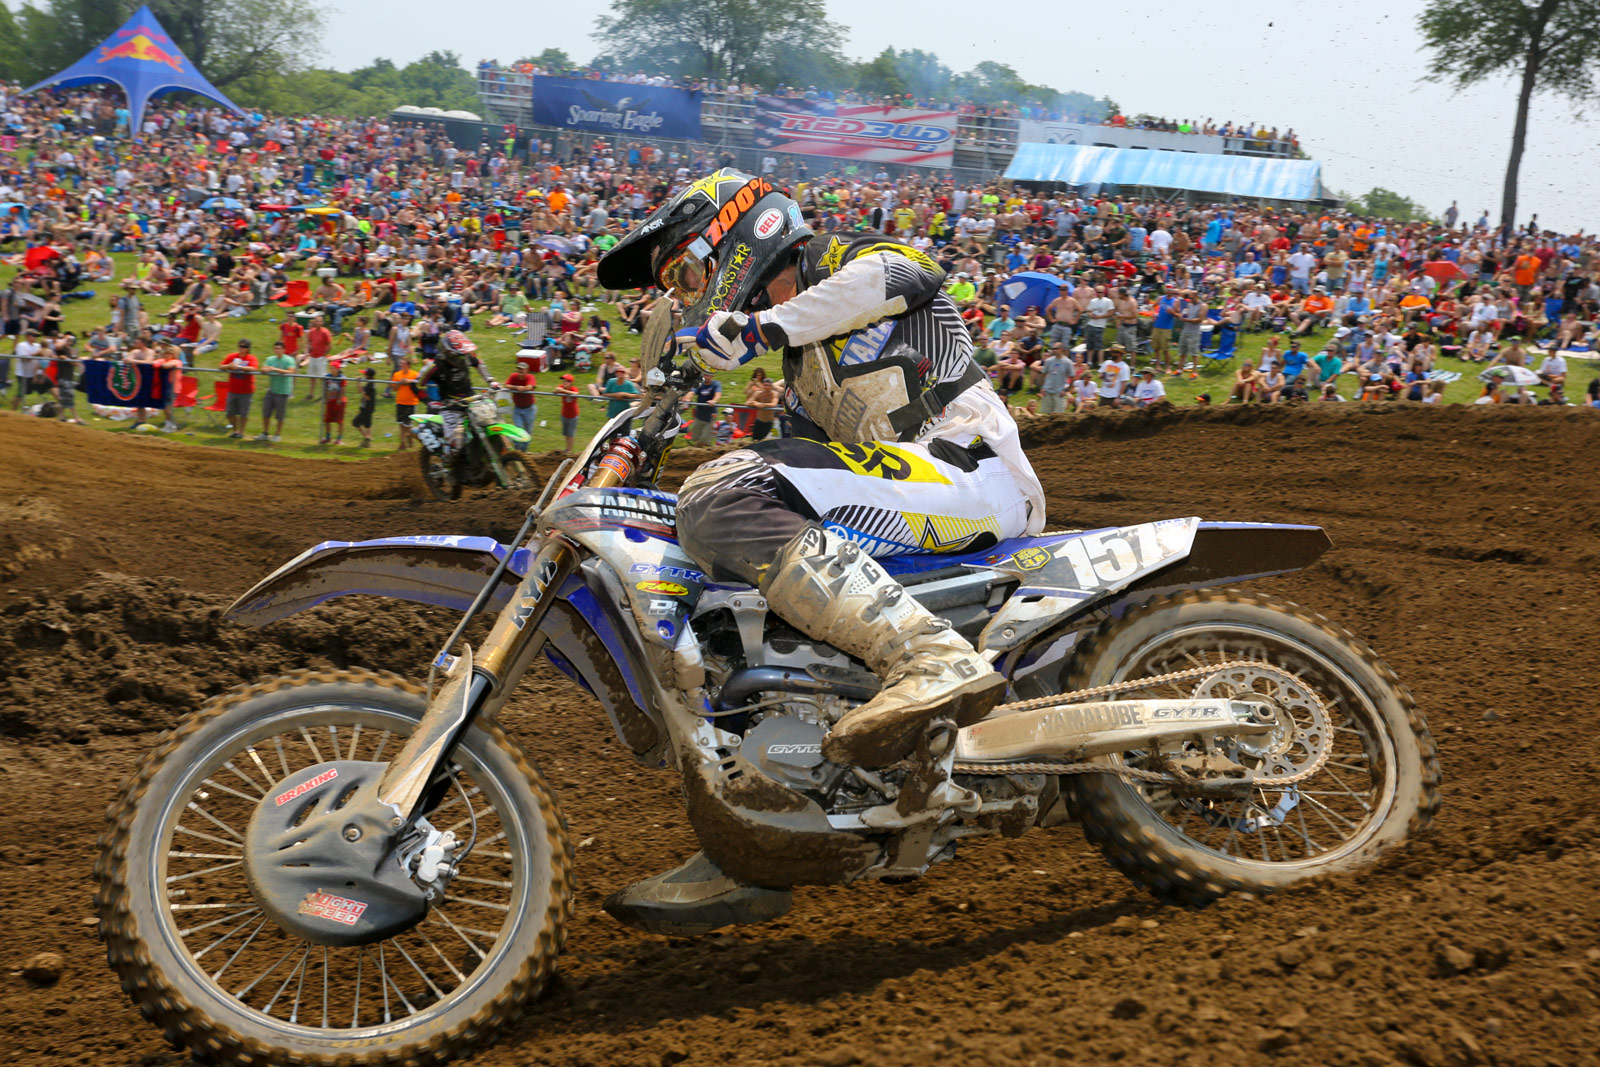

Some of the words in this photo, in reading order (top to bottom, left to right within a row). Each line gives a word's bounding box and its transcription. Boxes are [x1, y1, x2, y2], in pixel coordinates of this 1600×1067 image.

[566, 105, 624, 129] Soaring
[622, 110, 664, 132] Eagle
[705, 178, 773, 247] 100%
[758, 213, 780, 235] BELL
[721, 282, 741, 312] NERGY
[736, 256, 756, 281] DRINK
[603, 458, 628, 474] GET
[589, 494, 677, 526] YAMALU
[628, 563, 704, 582] GYTR
[640, 581, 688, 594] FMF
[953, 658, 978, 680] G
[1152, 706, 1224, 719] GYTR
[276, 769, 338, 806] BRAKING
[309, 892, 367, 915] IGHT
